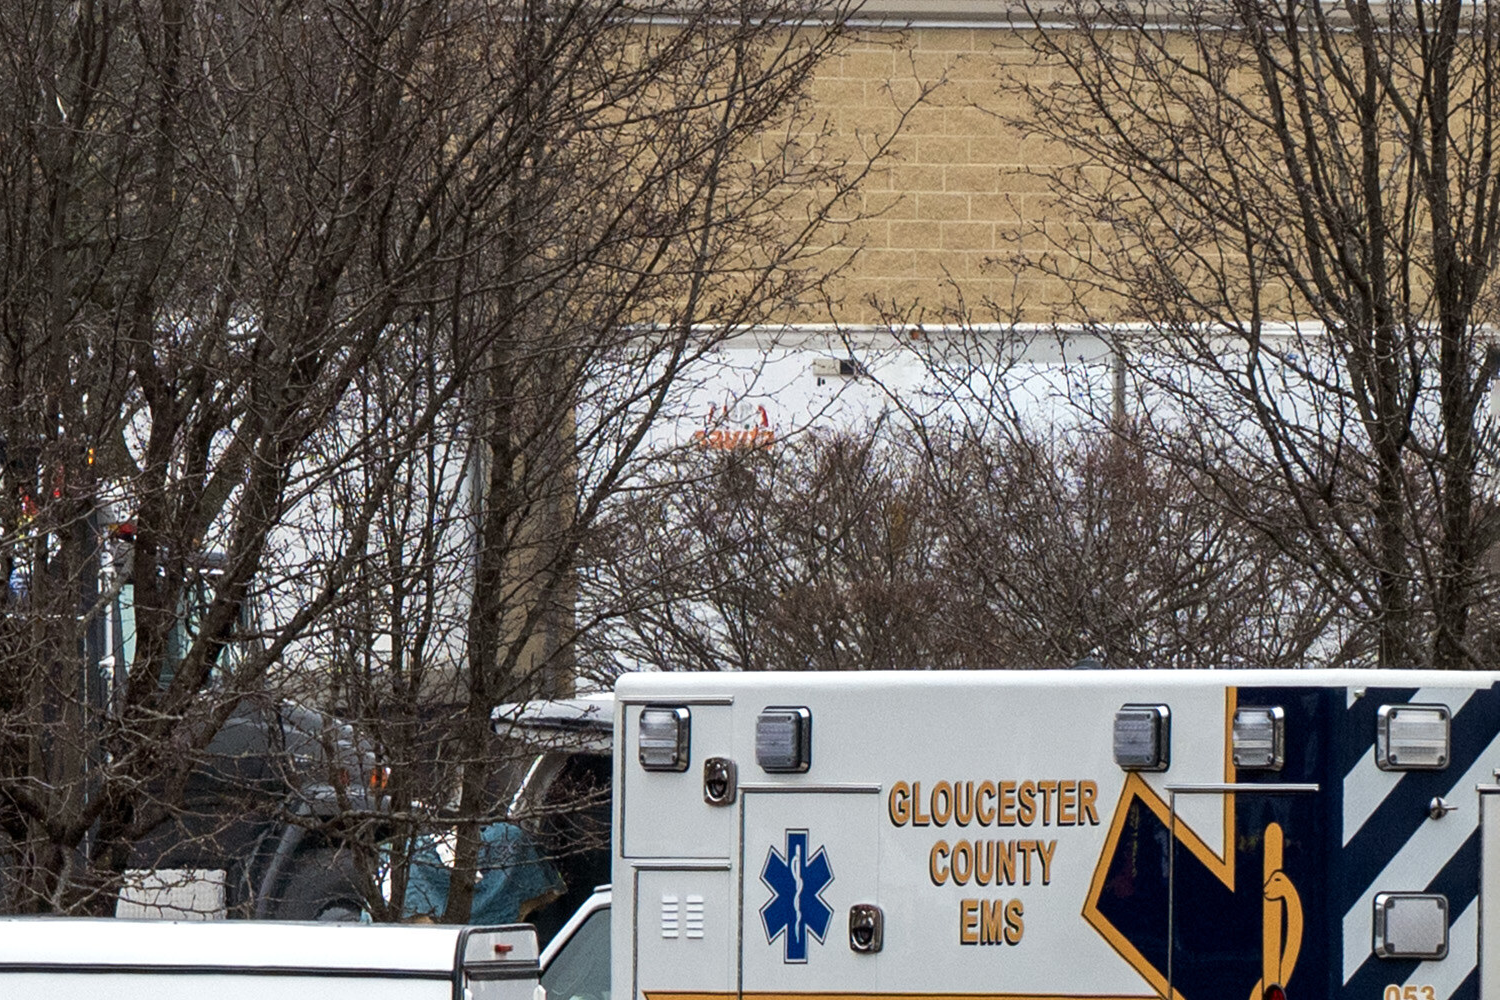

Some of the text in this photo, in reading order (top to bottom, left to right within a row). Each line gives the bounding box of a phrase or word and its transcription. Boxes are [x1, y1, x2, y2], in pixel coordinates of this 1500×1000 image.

[888, 779, 1100, 828] GLOUCESTER
[929, 839, 1058, 887] COUNTY
[959, 898, 1025, 946] EMS
